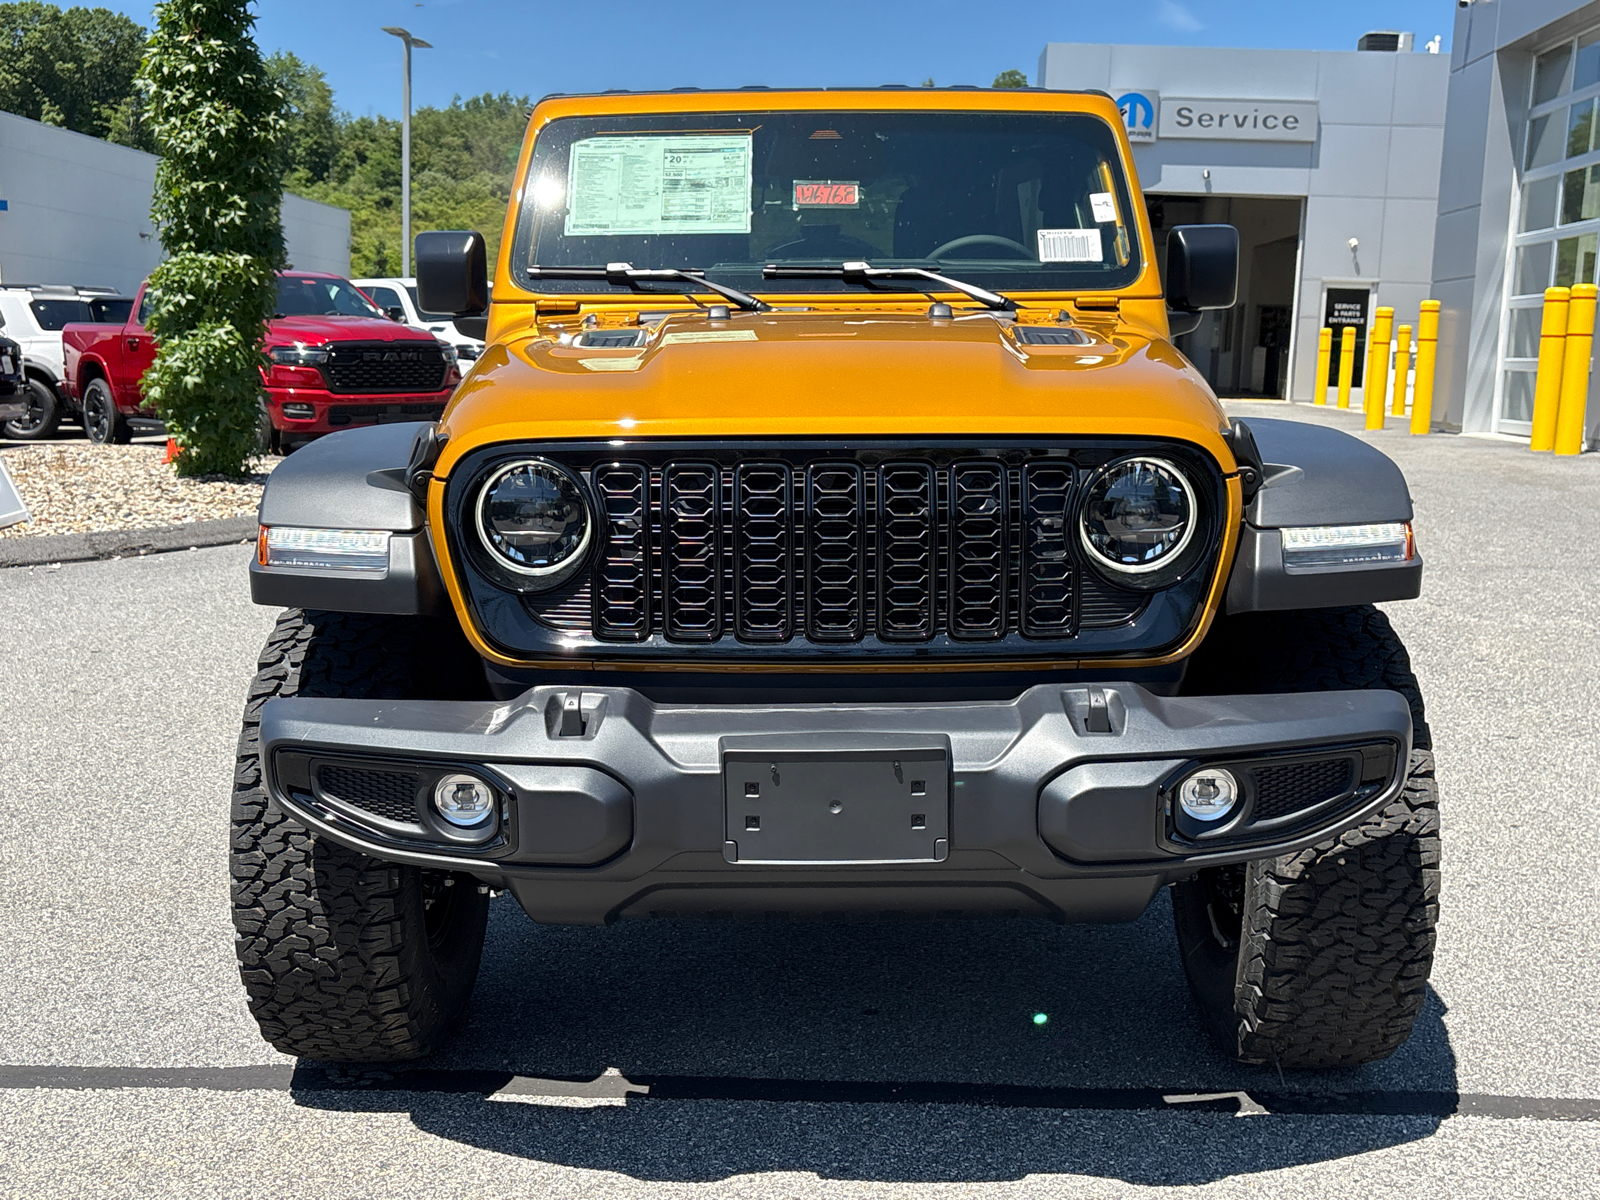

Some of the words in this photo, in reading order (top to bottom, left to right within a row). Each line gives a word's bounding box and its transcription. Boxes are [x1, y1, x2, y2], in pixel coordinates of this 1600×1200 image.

[1175, 106, 1300, 130] Service
[669, 155, 682, 163] 20
[1334, 302, 1361, 310] SERVICE
[1328, 317, 1365, 325] ENTRANCE
[362, 352, 418, 361] RAM
